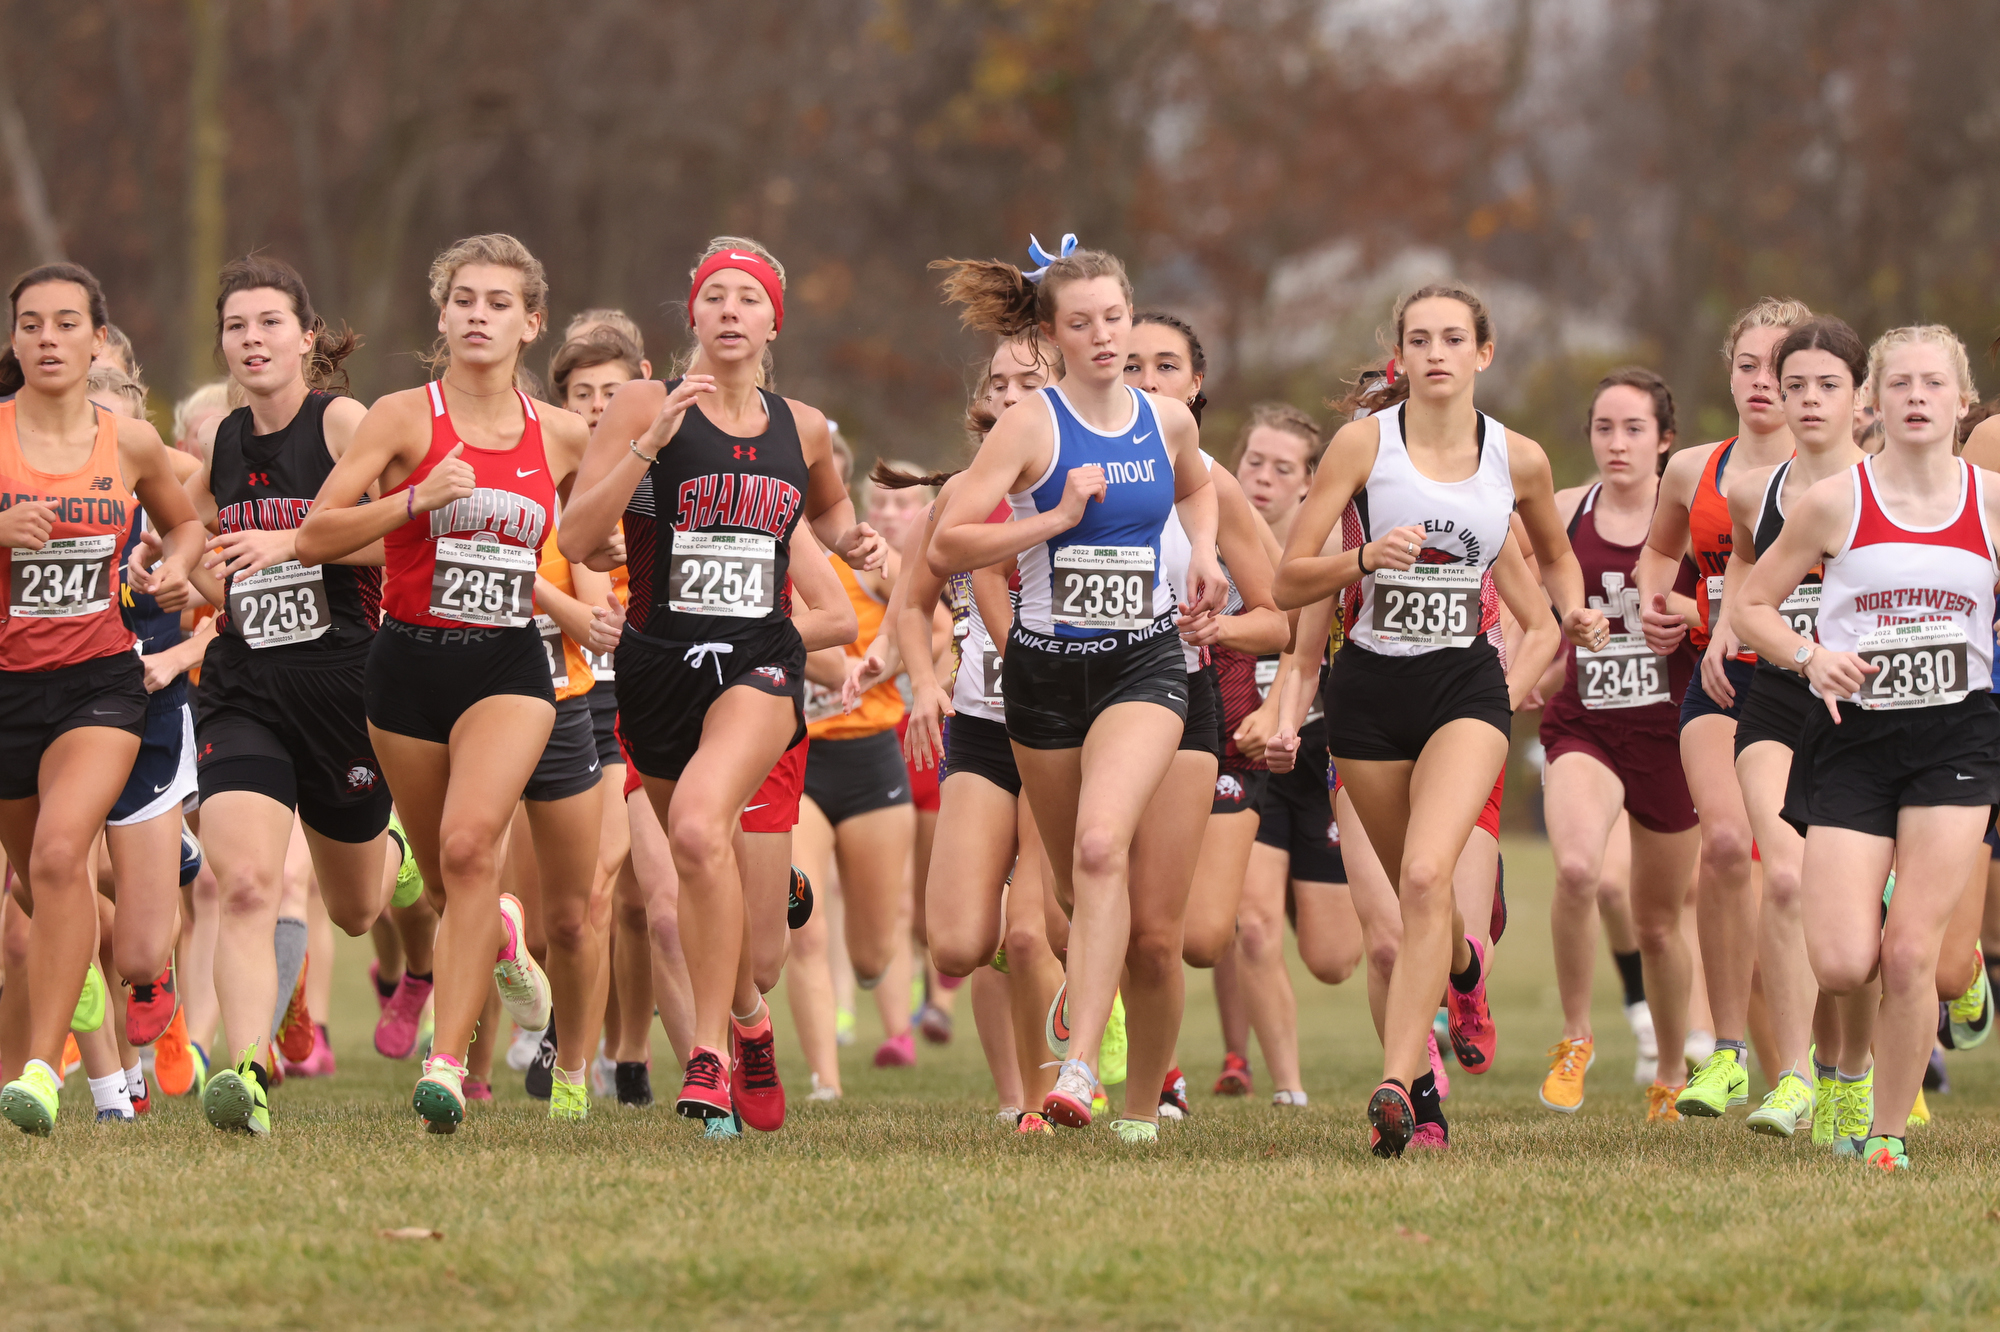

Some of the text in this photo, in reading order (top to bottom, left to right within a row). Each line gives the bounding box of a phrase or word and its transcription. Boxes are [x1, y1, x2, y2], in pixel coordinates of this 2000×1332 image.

[430, 487, 547, 549] WHIPPETS
[675, 473, 801, 542] SHAWNEE
[64, 546, 114, 554] Championships
[460, 552, 487, 560] Country
[488, 555, 535, 565] Championships
[476, 544, 501, 554] OHSAA
[724, 544, 773, 553] Championships
[1094, 549, 1118, 557] OHSAA
[1458, 528, 1480, 567] UNION
[21, 562, 104, 604] 2347
[249, 576, 272, 585] Country
[274, 570, 321, 582] Championships
[441, 567, 523, 613] 2351
[680, 559, 764, 603] 2254
[1063, 573, 1143, 615] 2339
[1398, 574, 1425, 582] Country
[240, 587, 319, 636] 2253
[1384, 590, 1468, 633] 2335
[1854, 588, 1977, 617] NORTHWEST
[384, 614, 504, 645] NIKE PRO
[1013, 614, 1174, 655] NIKE PRO NIKE
[1896, 625, 1922, 635] OHSAA
[1911, 632, 1963, 641] Championships
[1586, 657, 1659, 696] 2345
[1870, 649, 1956, 695] 2330
